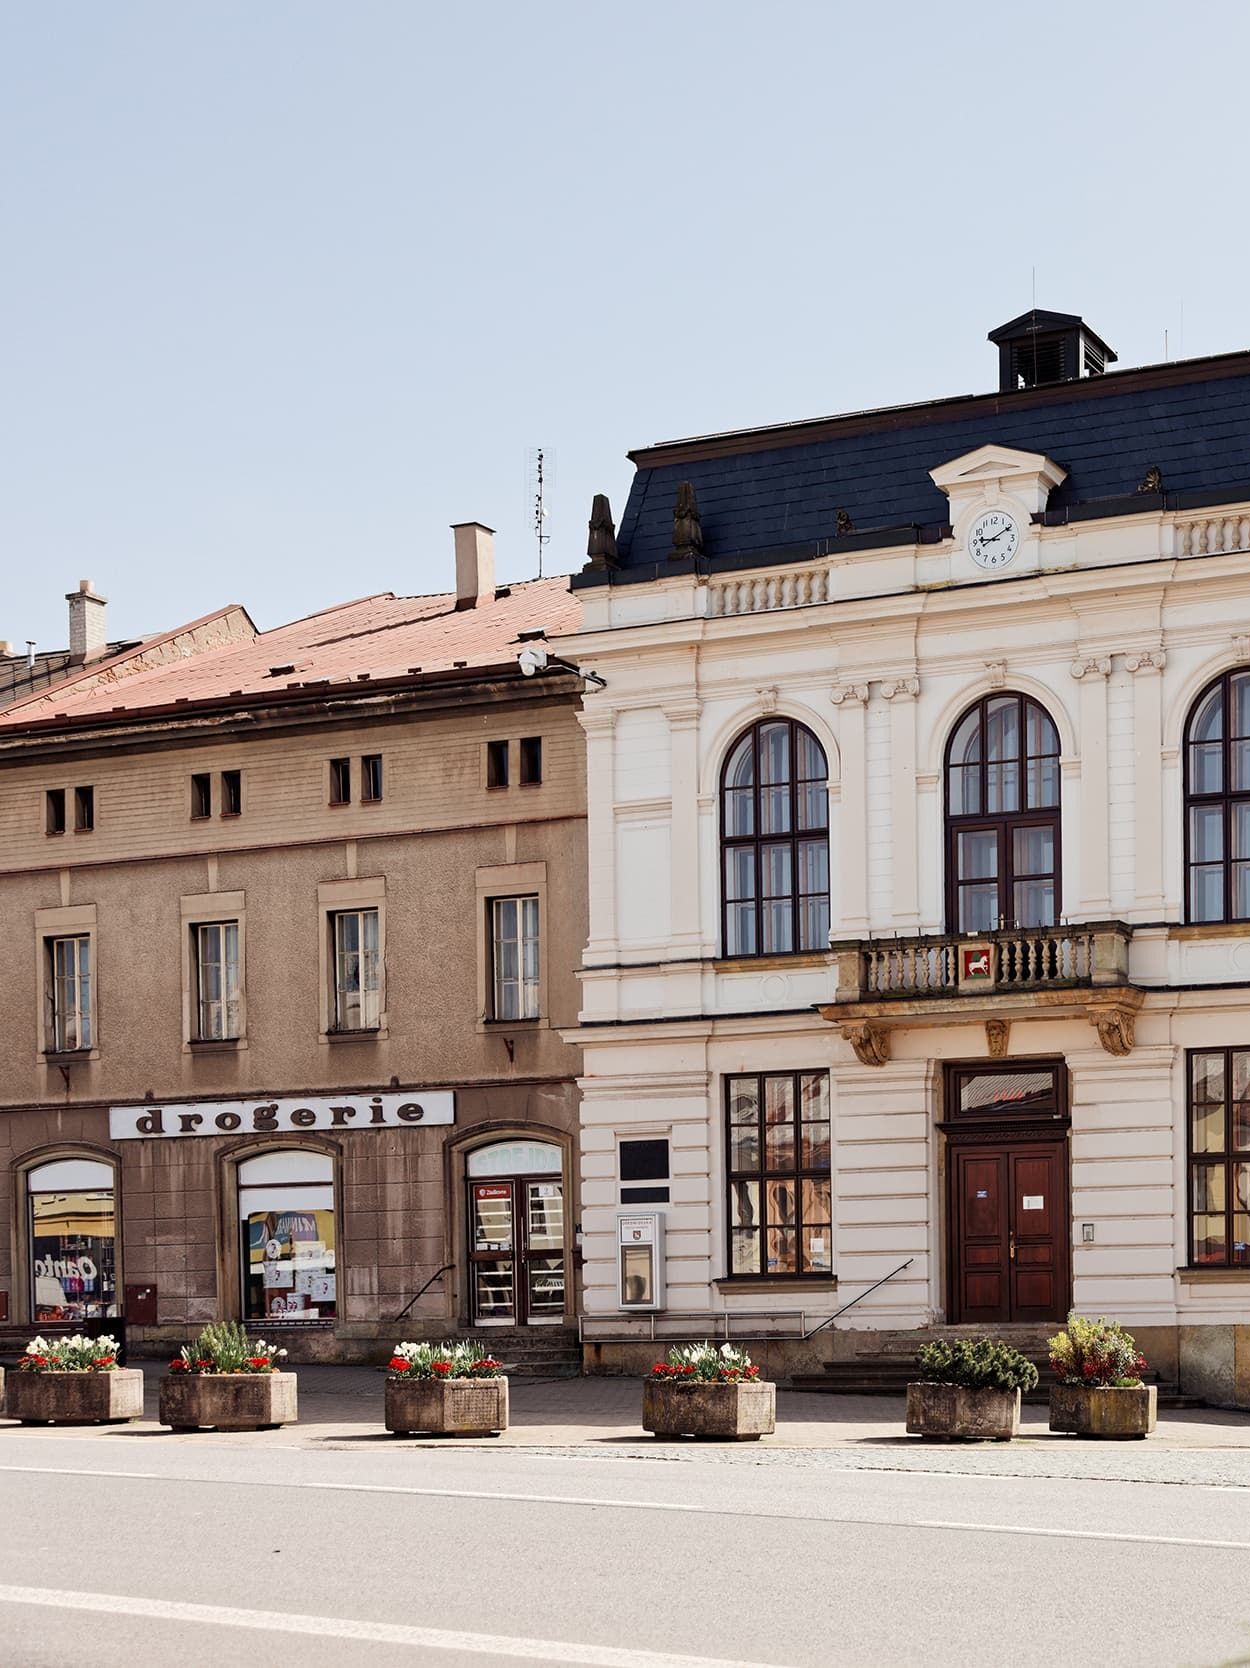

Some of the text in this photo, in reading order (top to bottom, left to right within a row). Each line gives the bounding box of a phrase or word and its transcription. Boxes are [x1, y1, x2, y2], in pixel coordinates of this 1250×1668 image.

[983, 520, 988, 528] 11
[991, 517, 998, 525] 12
[976, 528, 983, 536] 10
[1010, 534, 1015, 542] 3
[973, 539, 978, 547] 9
[976, 548, 981, 556] 8
[984, 554, 988, 562] 7
[1001, 553, 1005, 561] 5
[136, 1097, 424, 1134] drogerie
